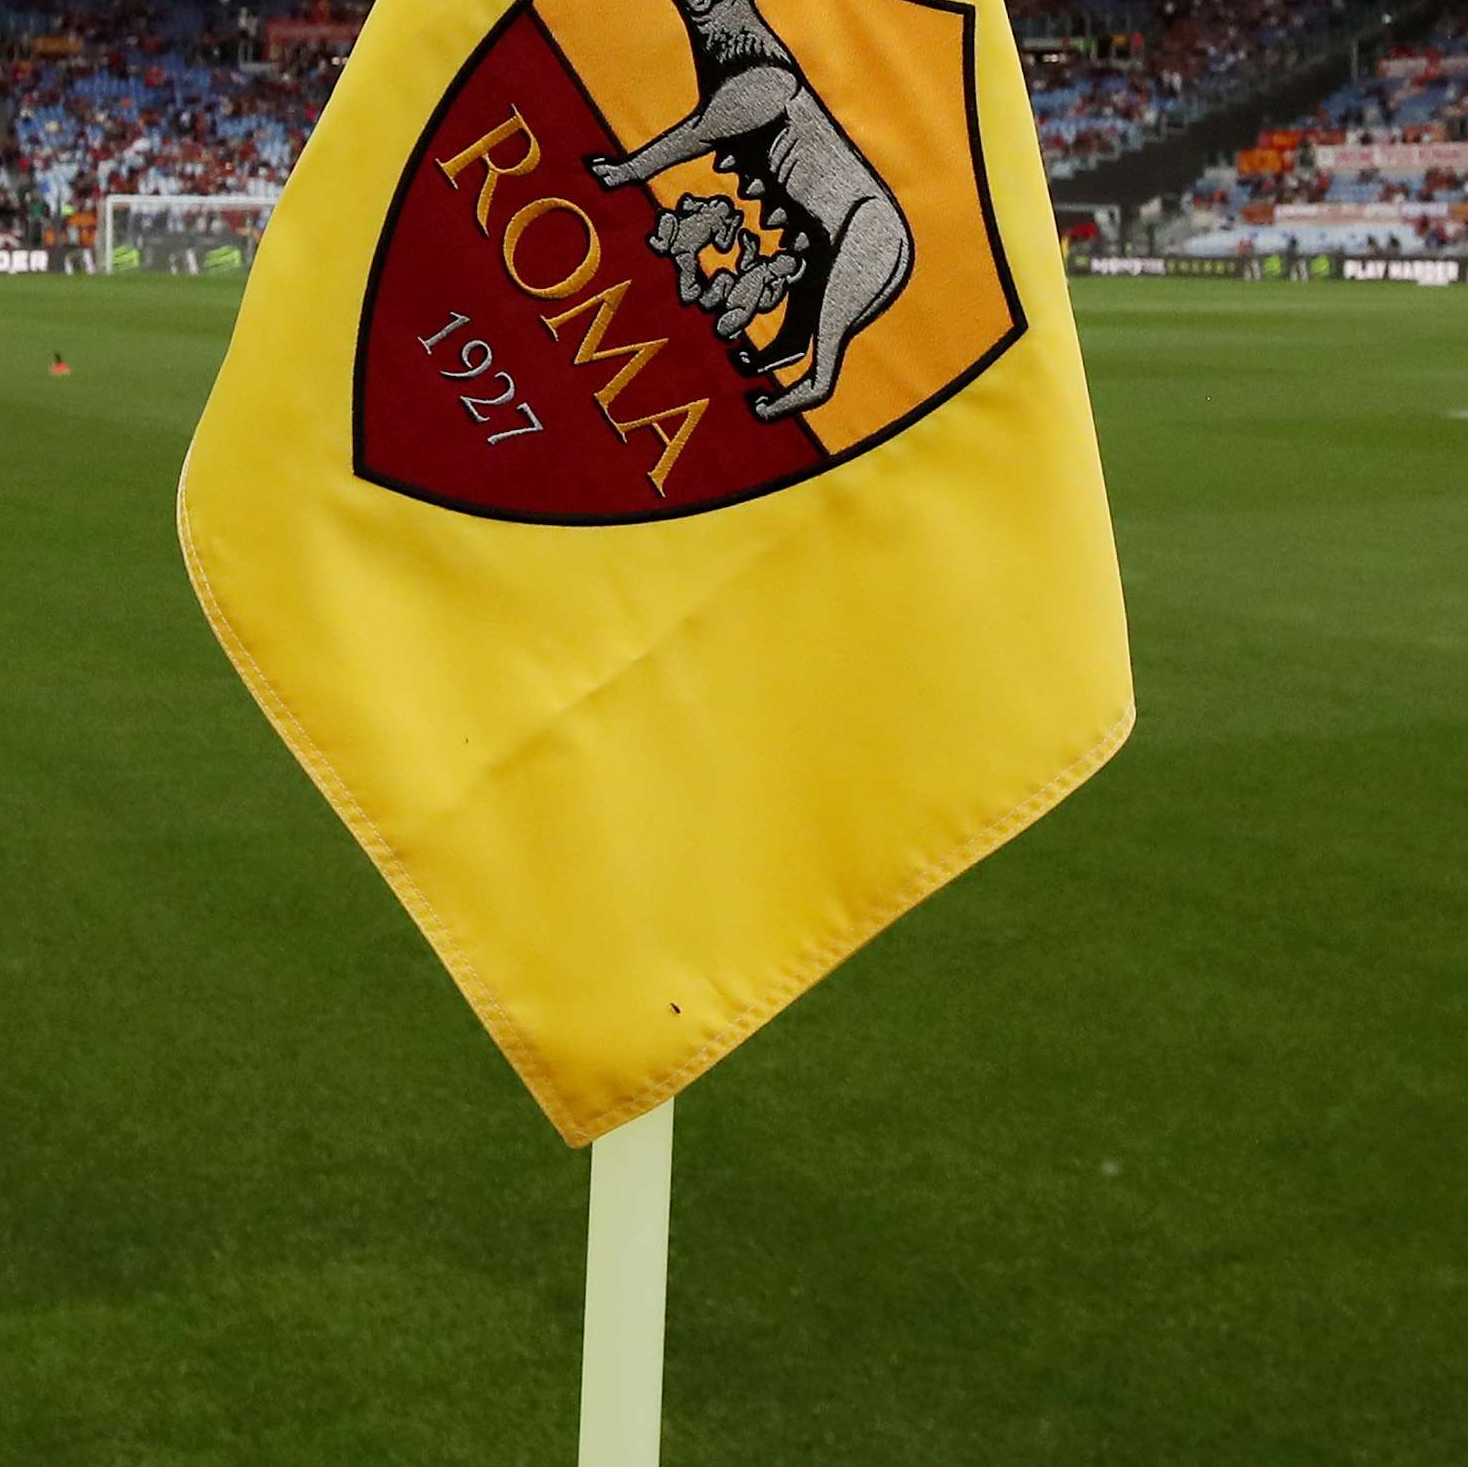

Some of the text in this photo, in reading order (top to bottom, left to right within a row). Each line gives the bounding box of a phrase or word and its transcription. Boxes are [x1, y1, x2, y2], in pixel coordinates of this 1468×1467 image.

[436, 104, 709, 497] ROMA
[1343, 260, 1387, 280] PLAY
[418, 312, 543, 445] 1927
